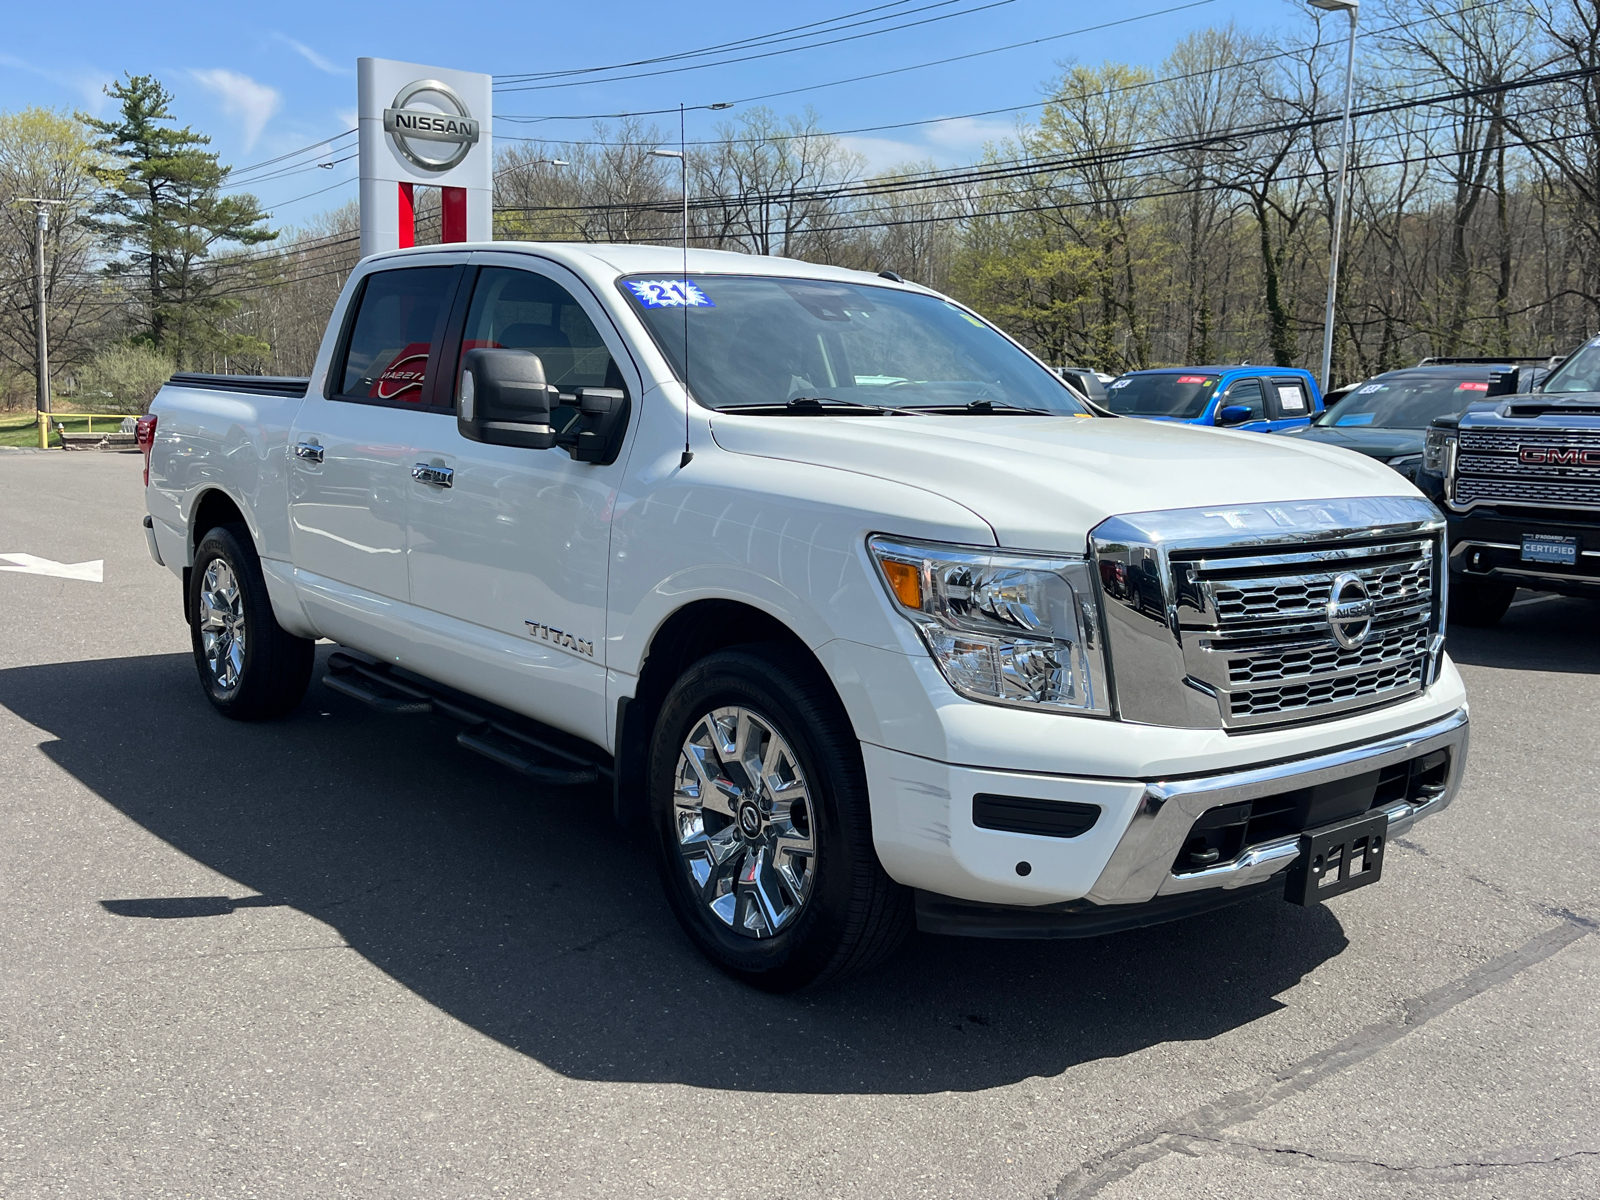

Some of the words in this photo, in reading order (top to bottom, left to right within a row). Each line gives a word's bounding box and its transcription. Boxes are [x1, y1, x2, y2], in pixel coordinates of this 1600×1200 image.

[395, 114, 472, 136] NISSAN
[648, 284, 688, 301] 21
[1520, 448, 1600, 464] GMC
[1524, 544, 1575, 555] CERTIFIED
[524, 620, 593, 657] TITAN
